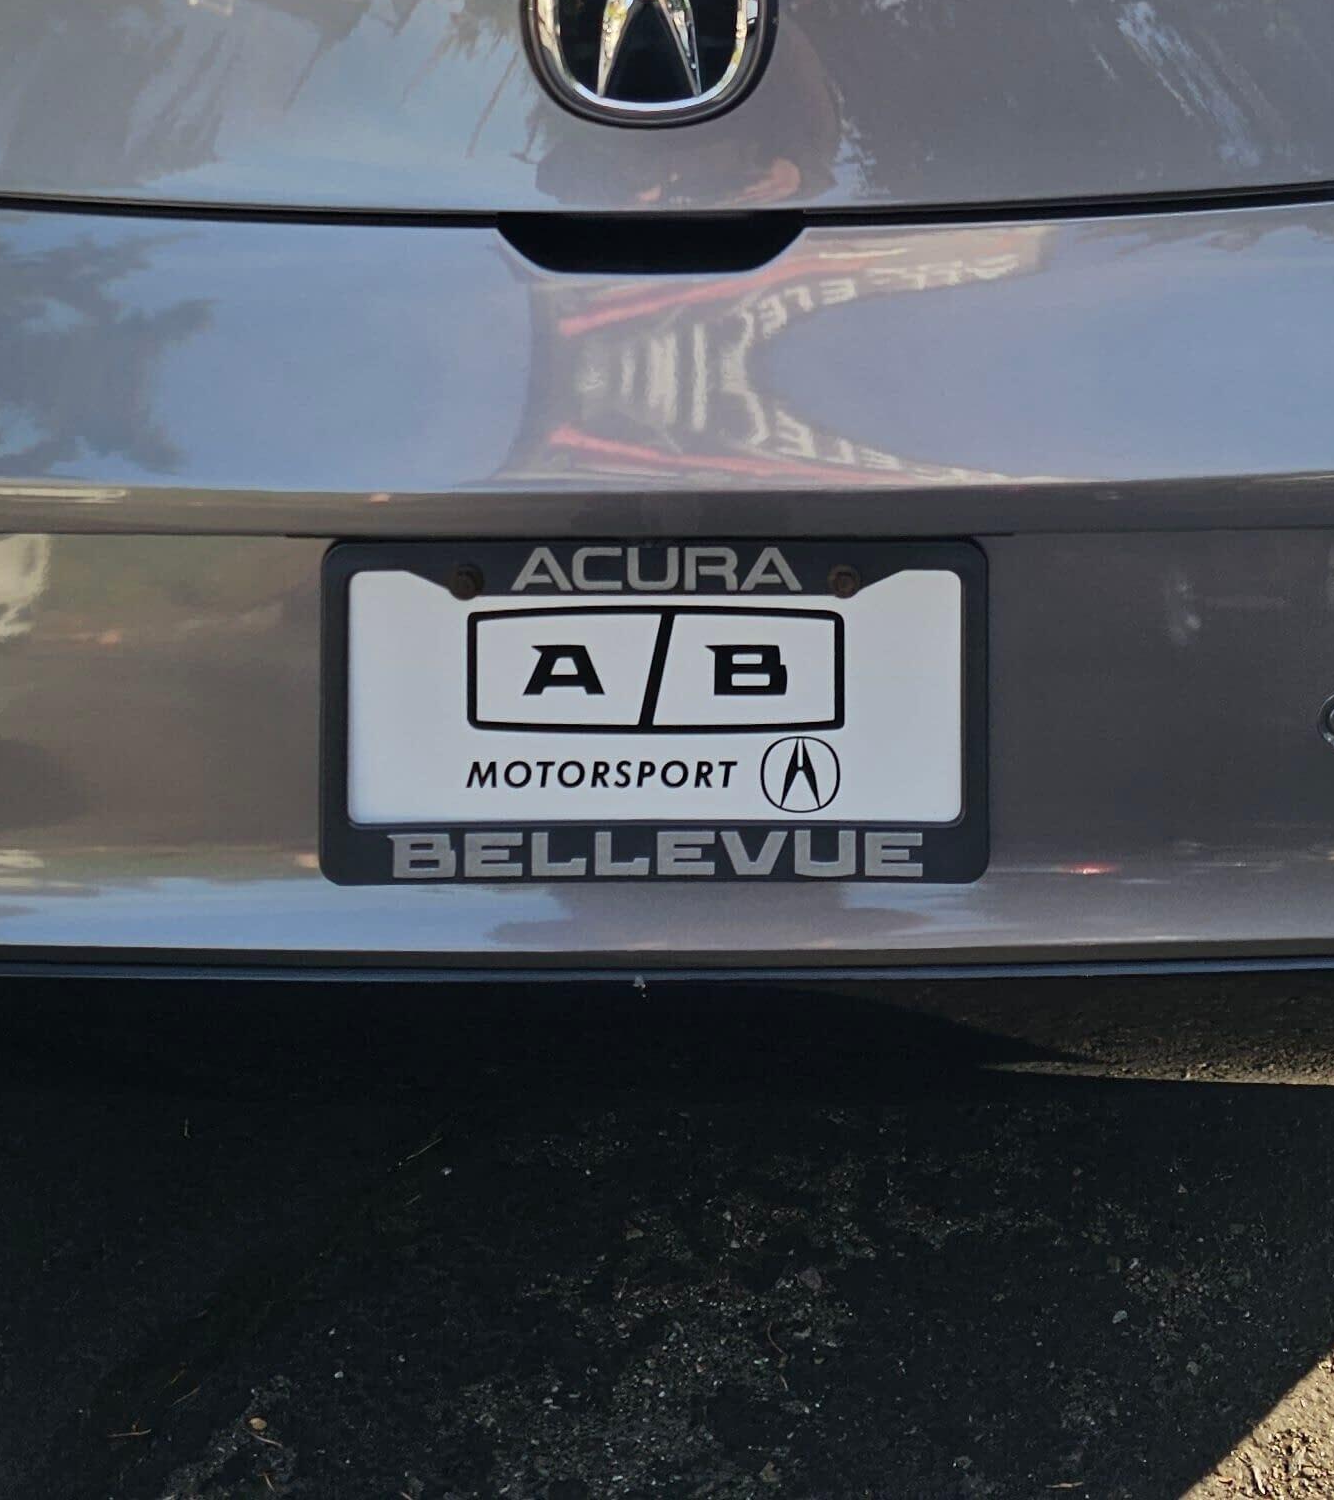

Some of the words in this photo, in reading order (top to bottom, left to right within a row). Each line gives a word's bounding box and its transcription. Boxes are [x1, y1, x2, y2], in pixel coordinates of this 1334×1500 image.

[511, 547, 803, 592] ACURA
[522, 644, 605, 696] A
[705, 644, 788, 696] B
[466, 760, 739, 789] MOTORSPORT
[386, 829, 924, 878] BELLEVUE
